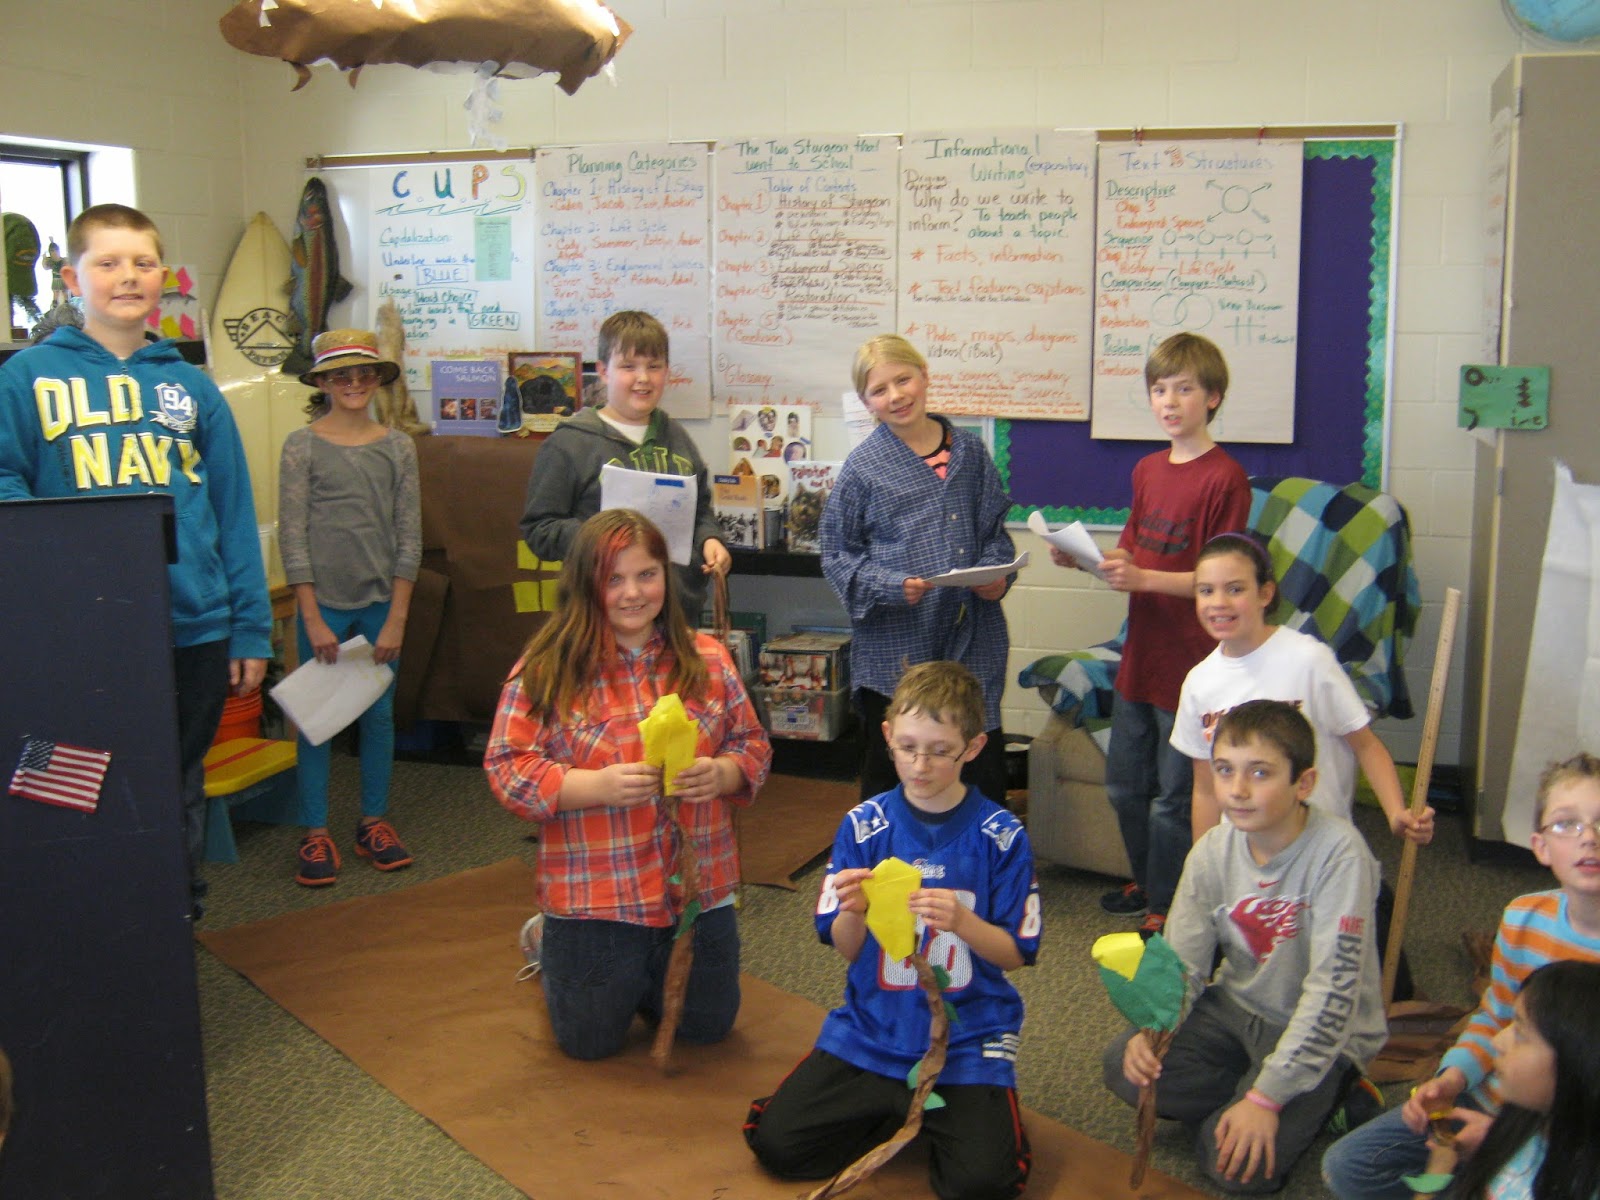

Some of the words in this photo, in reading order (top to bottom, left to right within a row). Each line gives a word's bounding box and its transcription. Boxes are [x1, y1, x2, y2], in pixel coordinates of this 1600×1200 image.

[735, 141, 759, 157] The
[794, 138, 848, 157] Sturgeon
[924, 134, 1040, 160] Informational
[567, 153, 623, 183] Planning
[629, 150, 698, 178] Categories
[810, 155, 853, 170] School
[1119, 151, 1160, 171] Text
[1186, 151, 1272, 171] Structures
[762, 177, 794, 192] Table
[799, 176, 811, 192] of
[971, 160, 1026, 189] Writing
[1106, 180, 1176, 200] Descriptive
[779, 193, 817, 210] History
[821, 195, 834, 207] of
[840, 194, 891, 211] Sturgeon
[913, 191, 942, 212] Why
[950, 188, 969, 206] do
[977, 194, 1000, 205] we
[1010, 188, 1048, 205] write
[1057, 189, 1074, 205] to
[973, 208, 991, 221] To
[998, 207, 1030, 222] teach
[1039, 207, 1078, 226] people
[968, 225, 1003, 239] about
[1014, 230, 1021, 238] a
[422, 267, 463, 283] BLUE
[471, 314, 515, 327] GREEN
[440, 365, 469, 375] COME
[471, 365, 496, 375] BACK
[456, 373, 497, 383] SALMON
[33, 374, 145, 442] OLD
[163, 388, 194, 417] 94
[69, 432, 202, 490] NAVY
[1283, 934, 1364, 1075] BASEBALL
